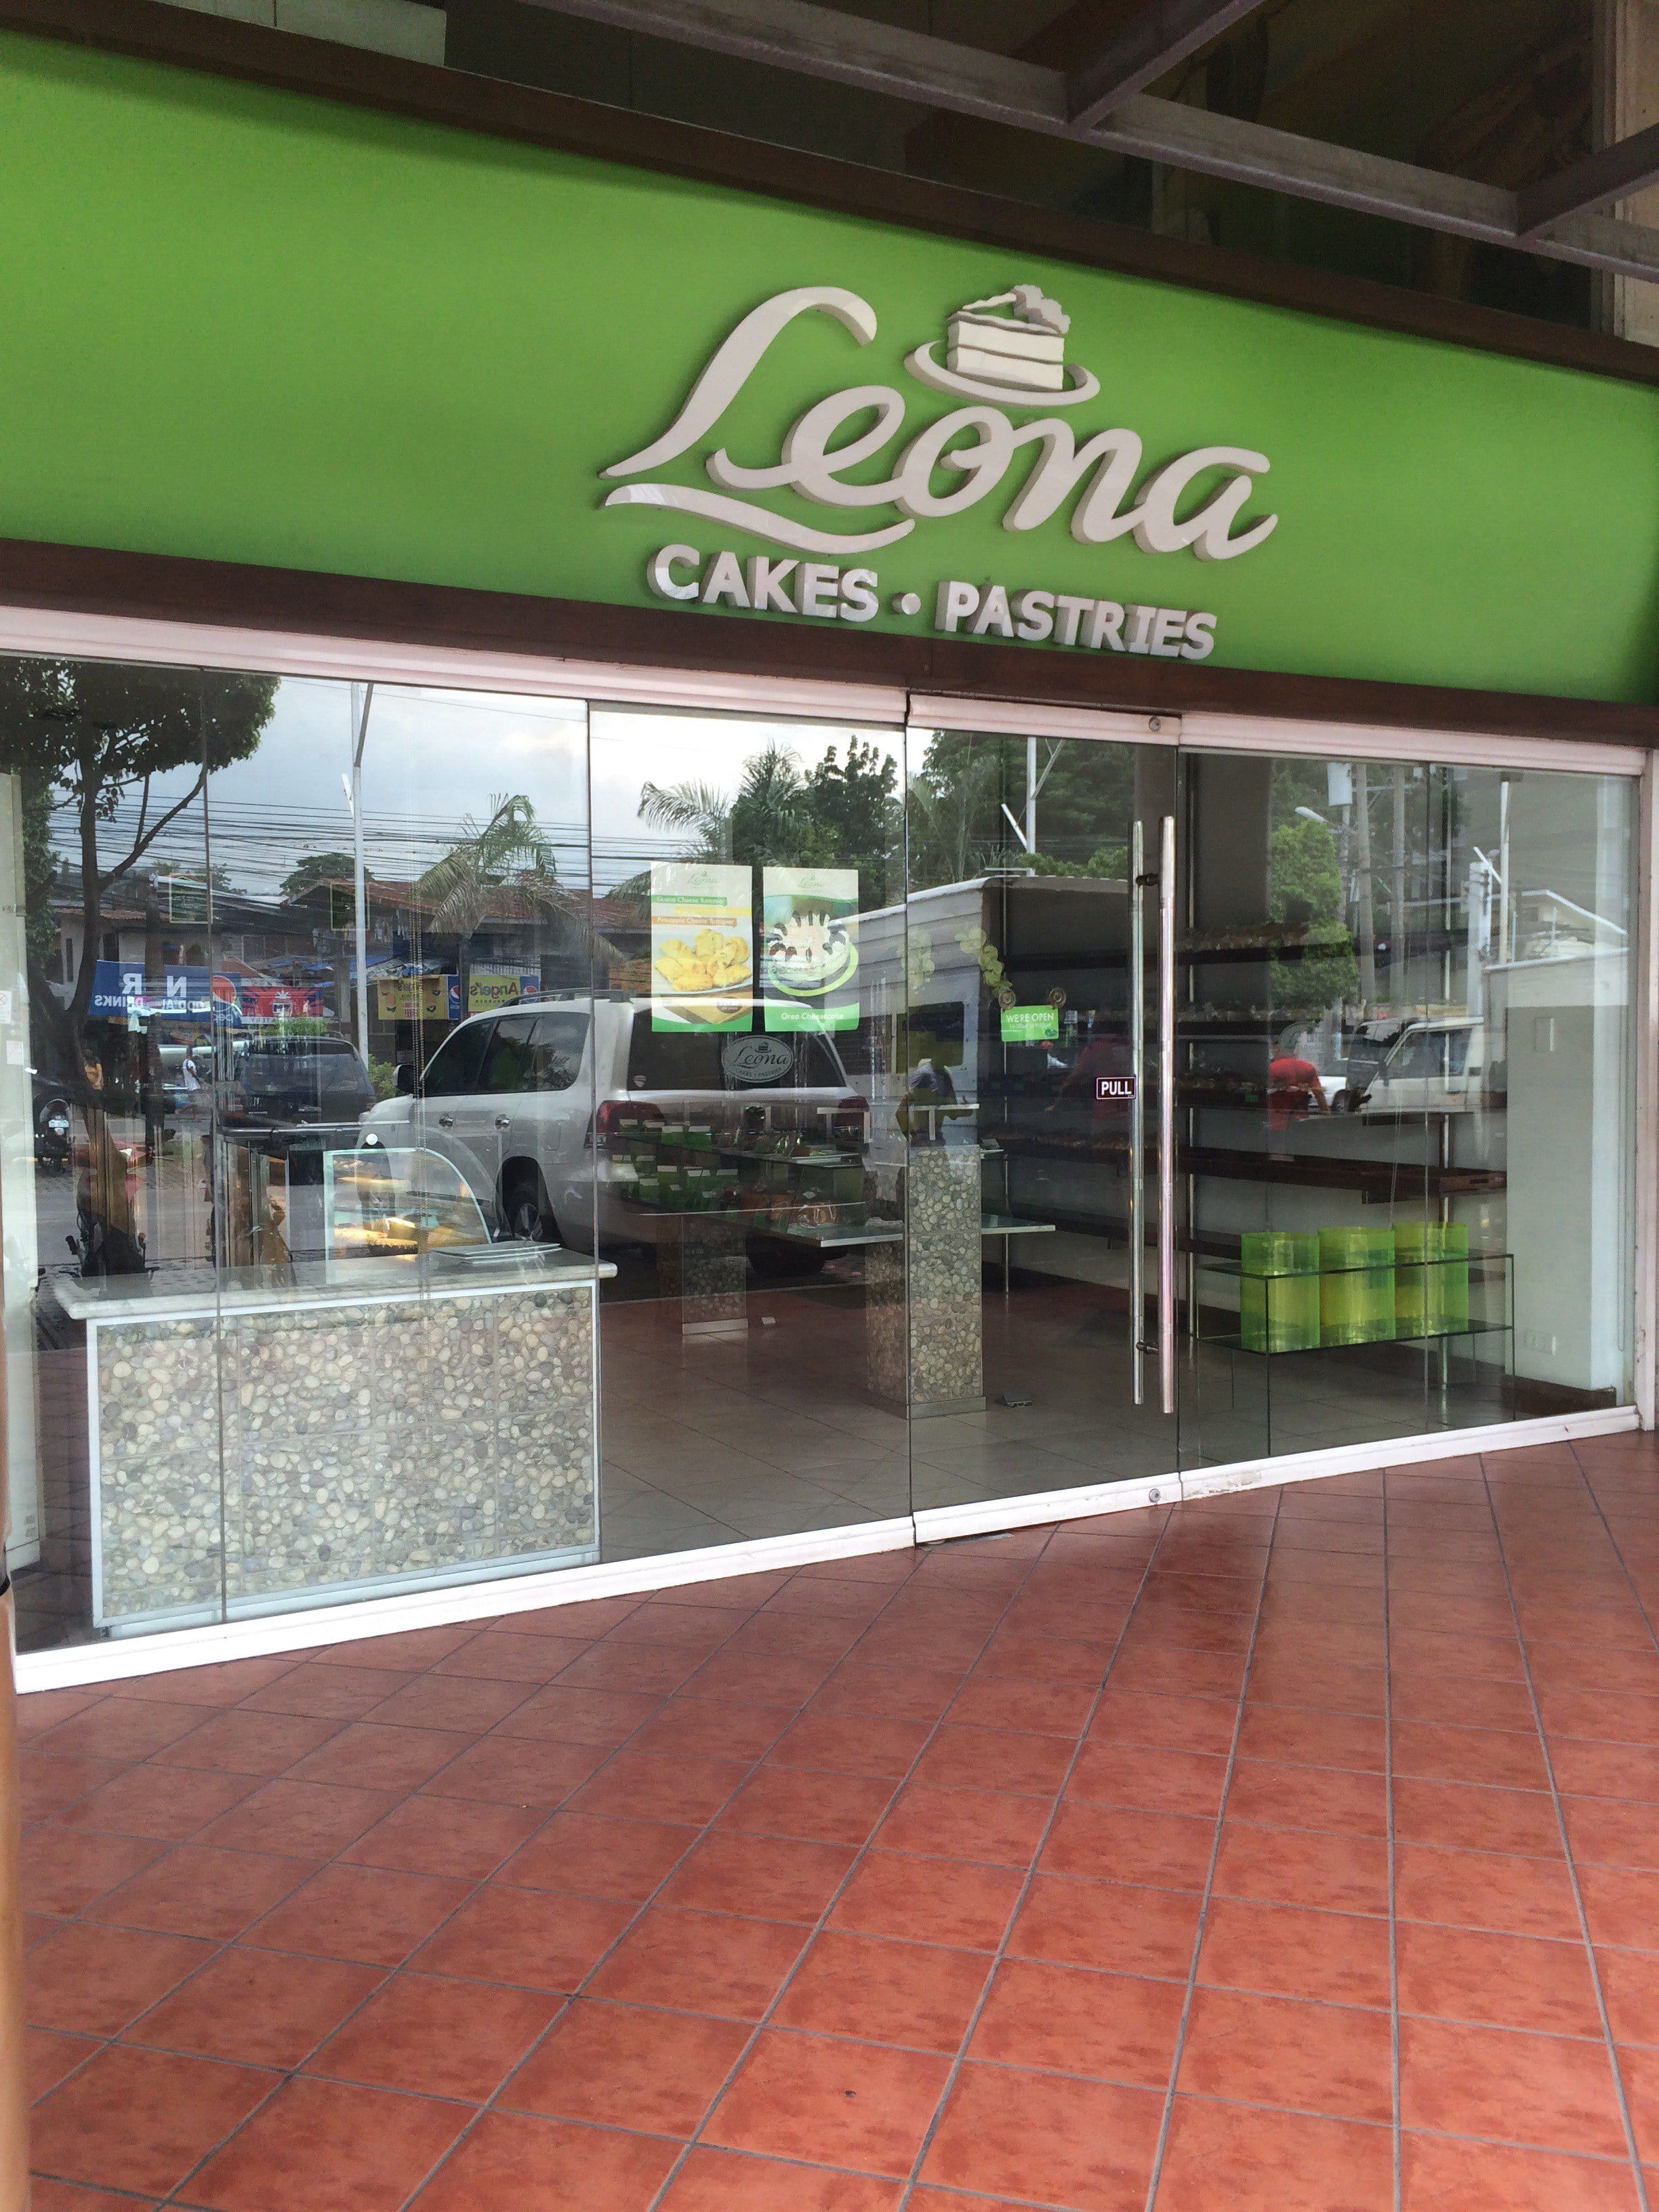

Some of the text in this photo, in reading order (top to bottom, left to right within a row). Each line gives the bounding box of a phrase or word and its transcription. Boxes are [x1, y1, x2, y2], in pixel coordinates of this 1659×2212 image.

[598, 285, 1279, 562] Leona
[647, 543, 1217, 661] CAKES PASTRIES
[1031, 1012, 1054, 1021] OPEN
[733, 1045, 789, 1069] Leona
[1101, 1080, 1132, 1095] PULL
